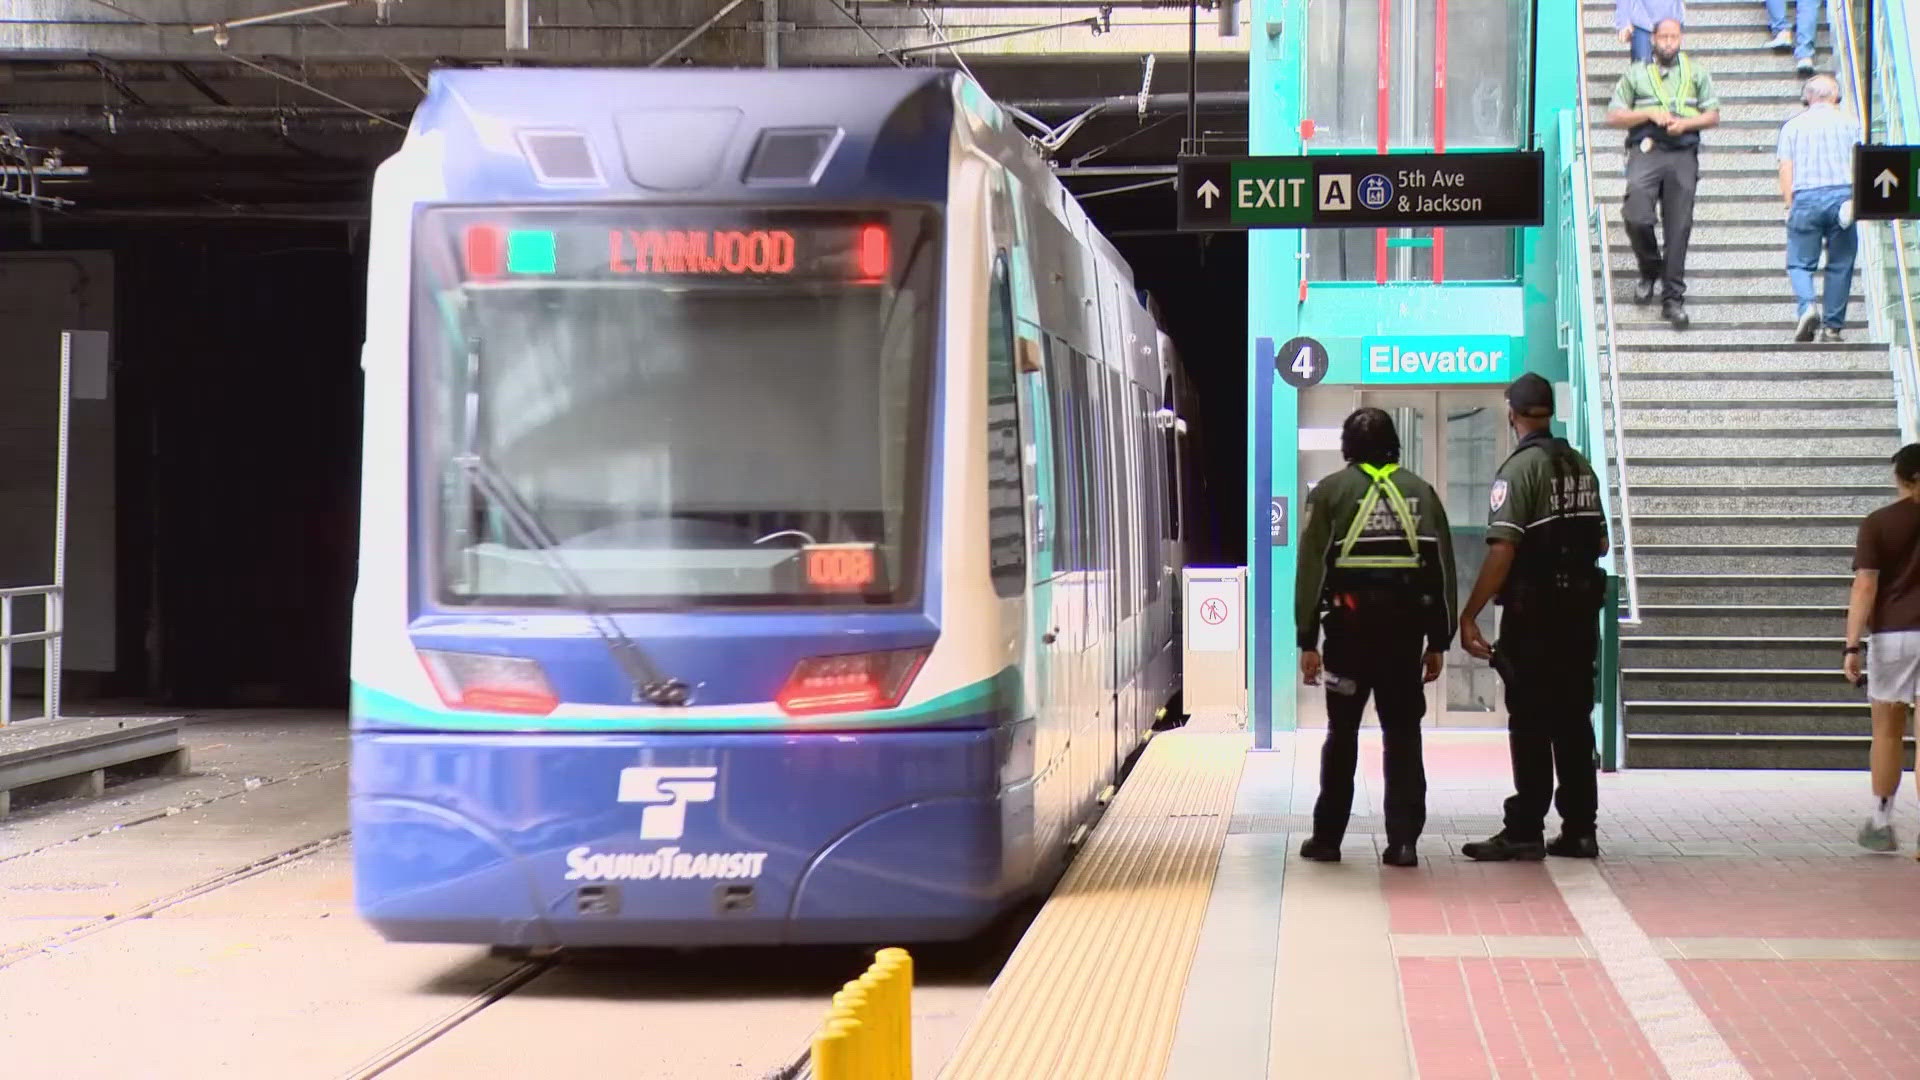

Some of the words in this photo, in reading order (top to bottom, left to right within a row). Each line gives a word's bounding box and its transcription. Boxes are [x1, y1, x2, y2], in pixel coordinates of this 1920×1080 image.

[1324, 179, 1346, 206] A
[1398, 169, 1426, 188] 5th
[1431, 169, 1465, 188] Ave
[1237, 178, 1305, 209] EXIT
[1397, 195, 1411, 212] &
[1415, 193, 1482, 212] Jackson
[608, 230, 796, 274] LYNNWOOD
[1291, 346, 1315, 379] 4
[1369, 345, 1503, 374] Elevator
